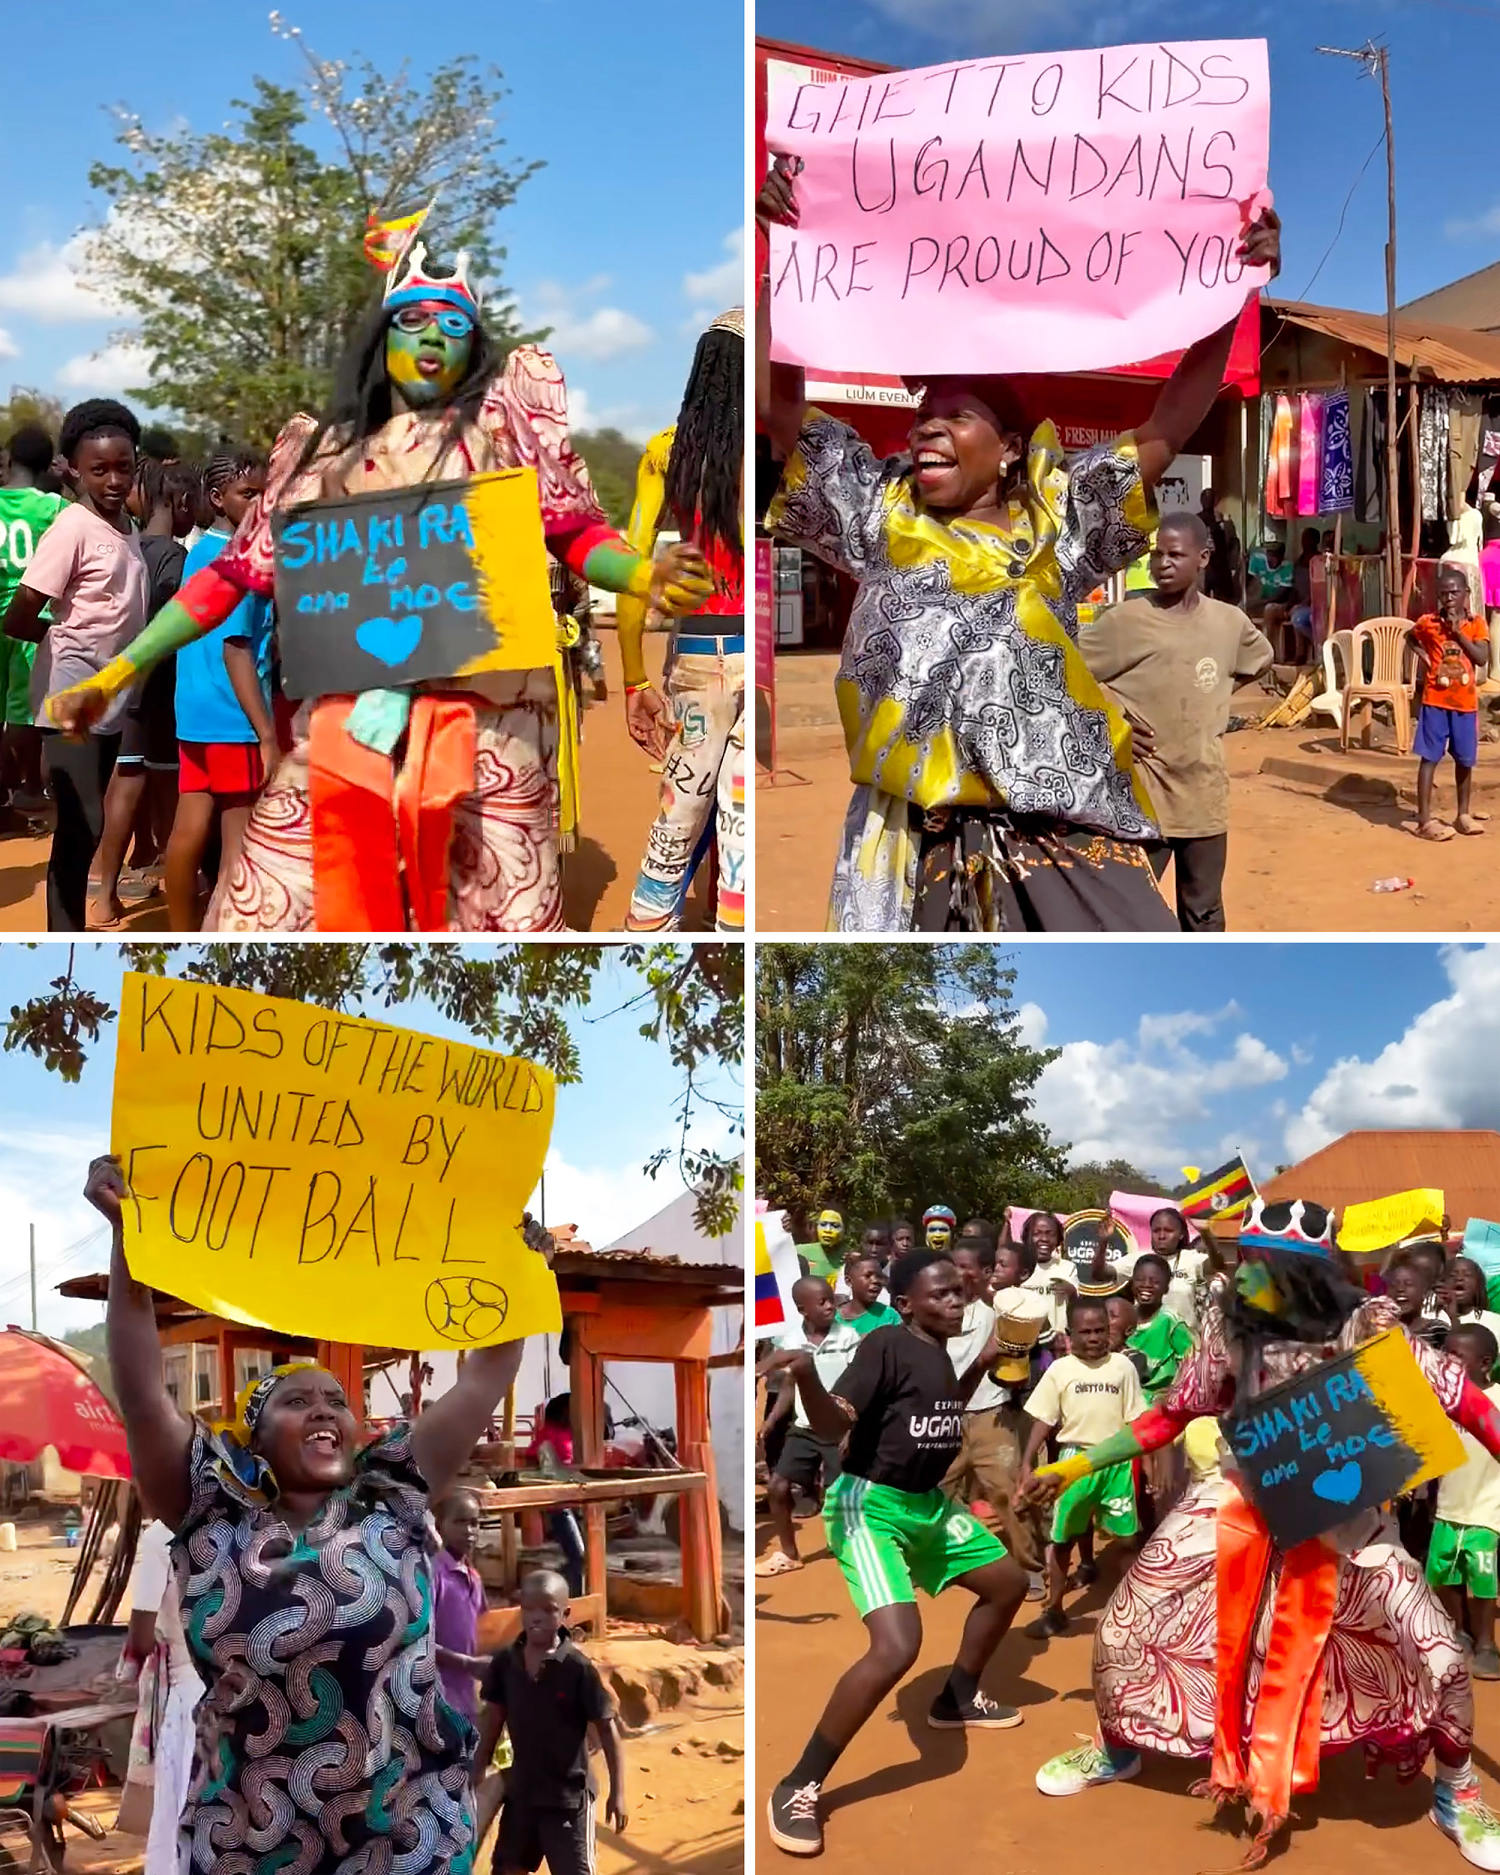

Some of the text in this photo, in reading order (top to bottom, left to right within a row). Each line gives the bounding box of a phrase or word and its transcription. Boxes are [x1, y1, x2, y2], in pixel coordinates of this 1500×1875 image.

[788, 46, 1250, 133] GHETTO KIDS
[853, 127, 1242, 213] UGANDANS
[775, 227, 1245, 302] ARE PROUD OF YOU
[846, 387, 876, 400] LIUM
[141, 982, 544, 1114] KIDS OF THE WORLD
[197, 1082, 466, 1183] UNITED BY
